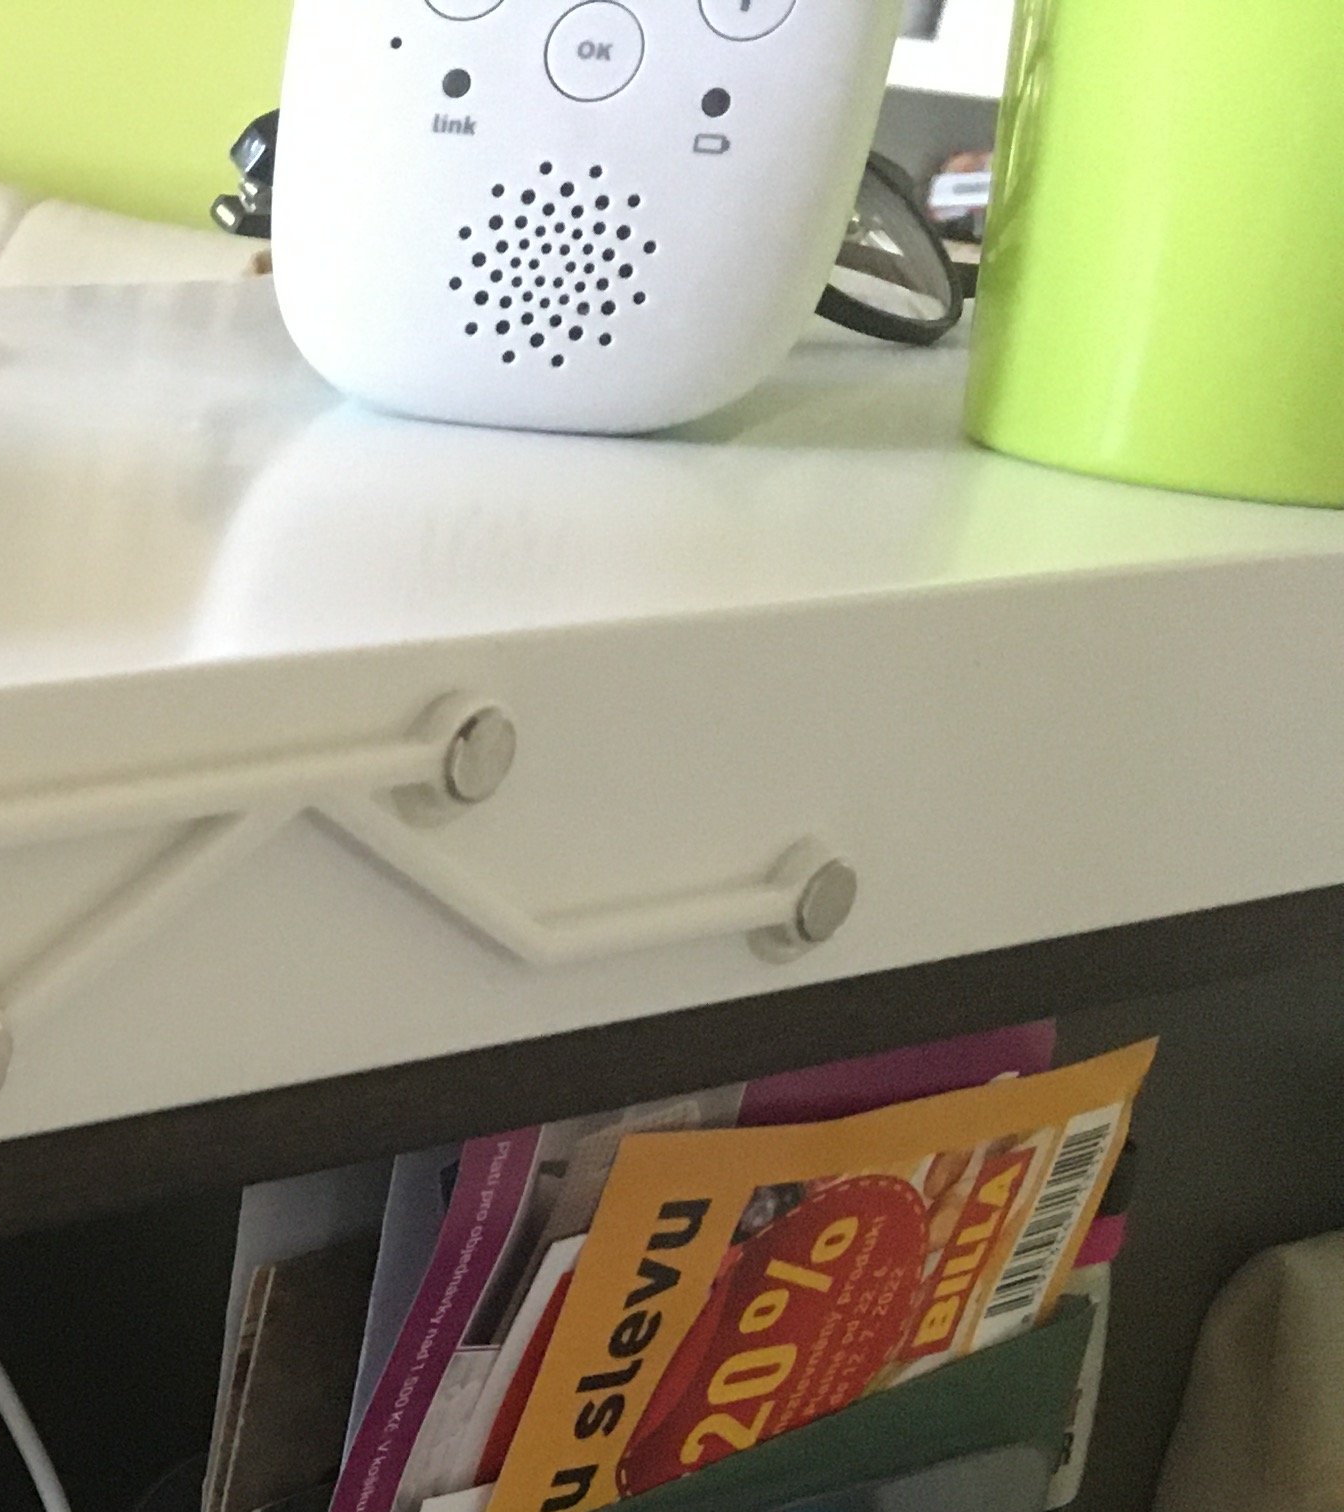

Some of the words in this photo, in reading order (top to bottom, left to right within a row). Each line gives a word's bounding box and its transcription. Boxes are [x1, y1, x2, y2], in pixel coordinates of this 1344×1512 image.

[576, 40, 613, 61] OK
[431, 113, 477, 136] link
[476, 1190, 494, 1222] pro
[912, 1162, 1023, 1348] BILLA
[573, 1197, 713, 1441] slevu
[416, 1326, 439, 1361] nad
[678, 1215, 860, 1465] 20%
